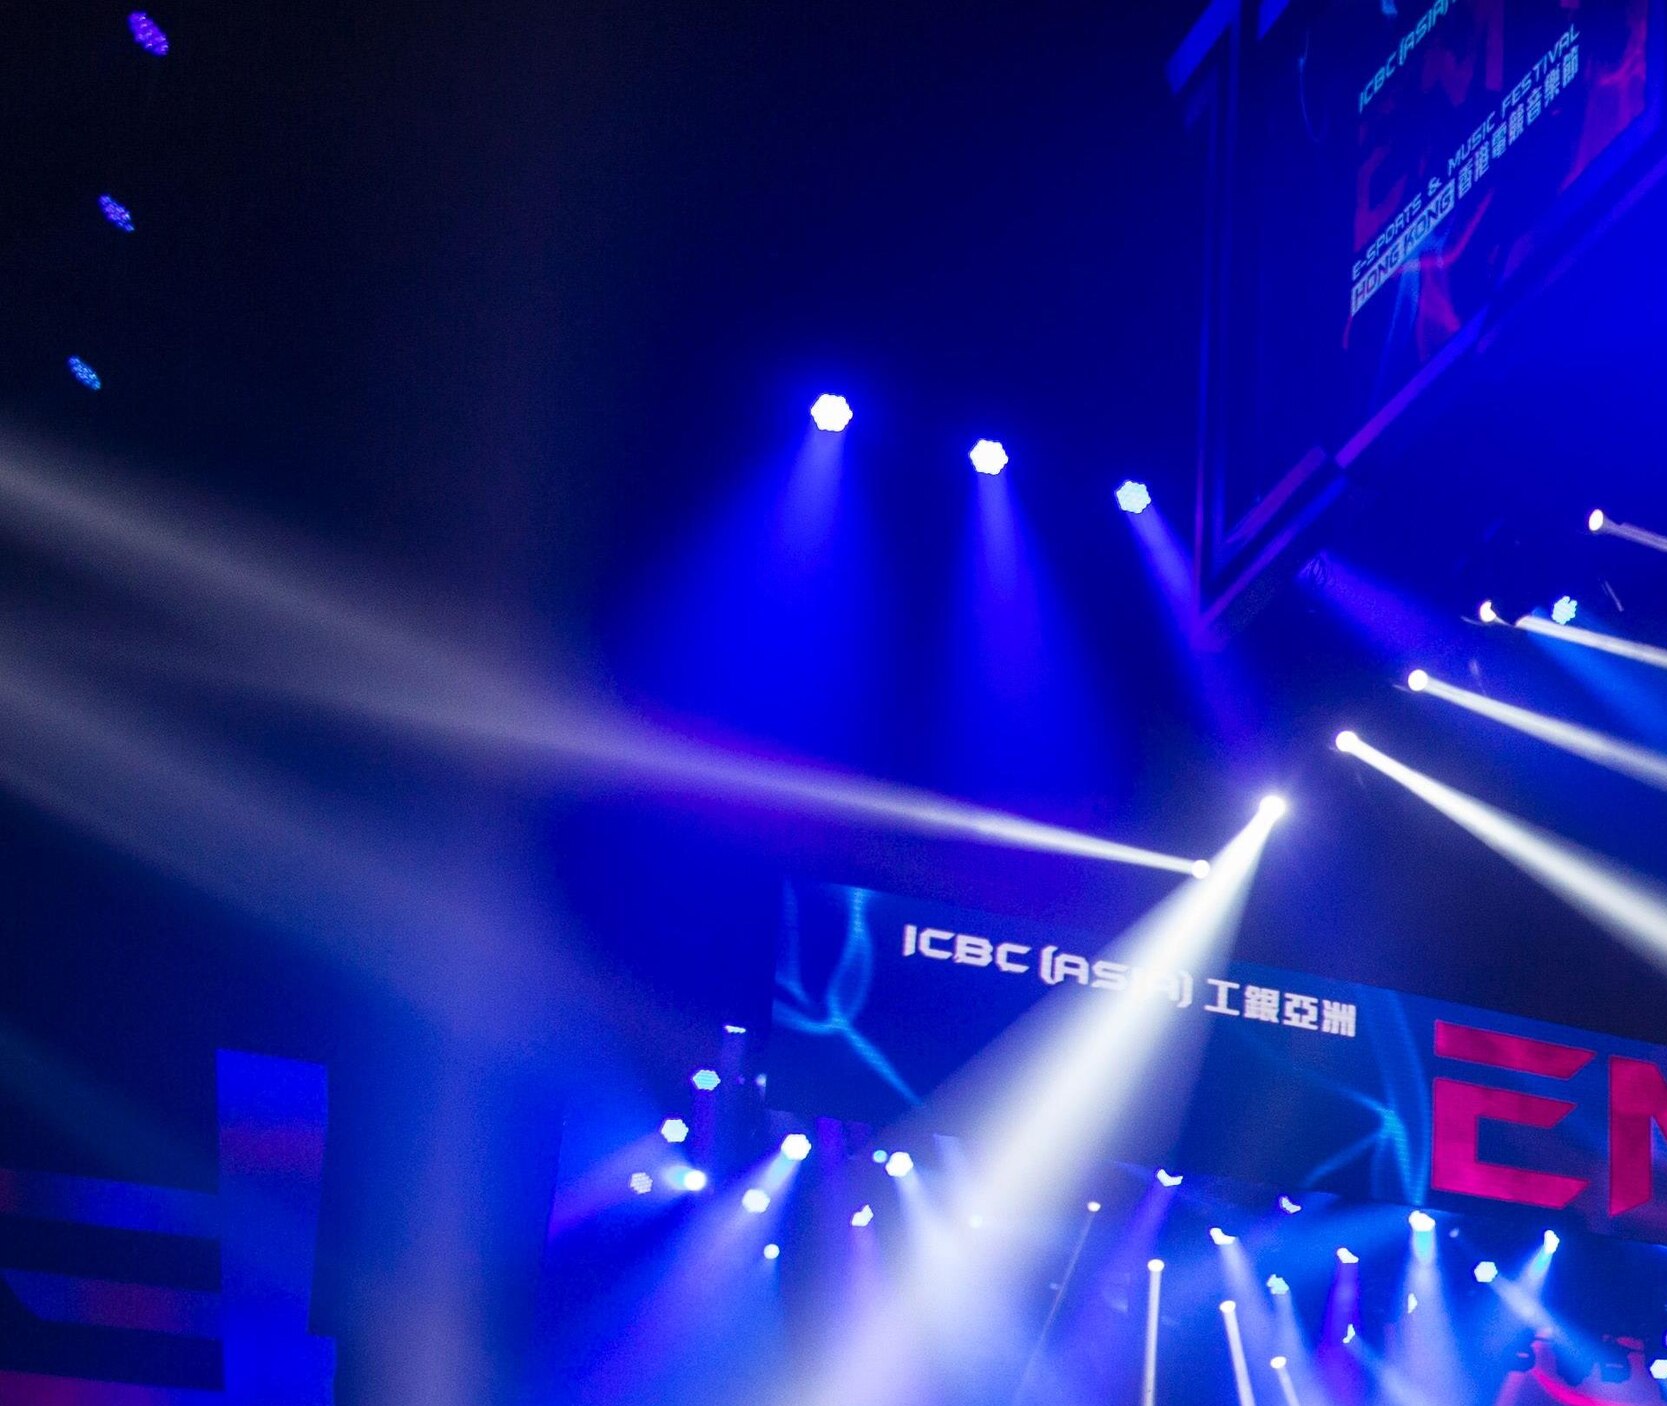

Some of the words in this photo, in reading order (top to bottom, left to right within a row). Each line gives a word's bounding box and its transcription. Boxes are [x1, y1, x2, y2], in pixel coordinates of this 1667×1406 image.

[1359, 51, 1397, 114] ICBC
[1352, 192, 1422, 281] E-SPORTS
[1428, 176, 1442, 197] &
[1448, 110, 1496, 177] MUSIC
[1502, 23, 1580, 119] FESTIVAL
[1353, 246, 1401, 309] HONG
[1401, 184, 1454, 250] KONG
[903, 924, 1032, 974] ICBC
[1204, 977, 1356, 1038] 工銀亞洲
